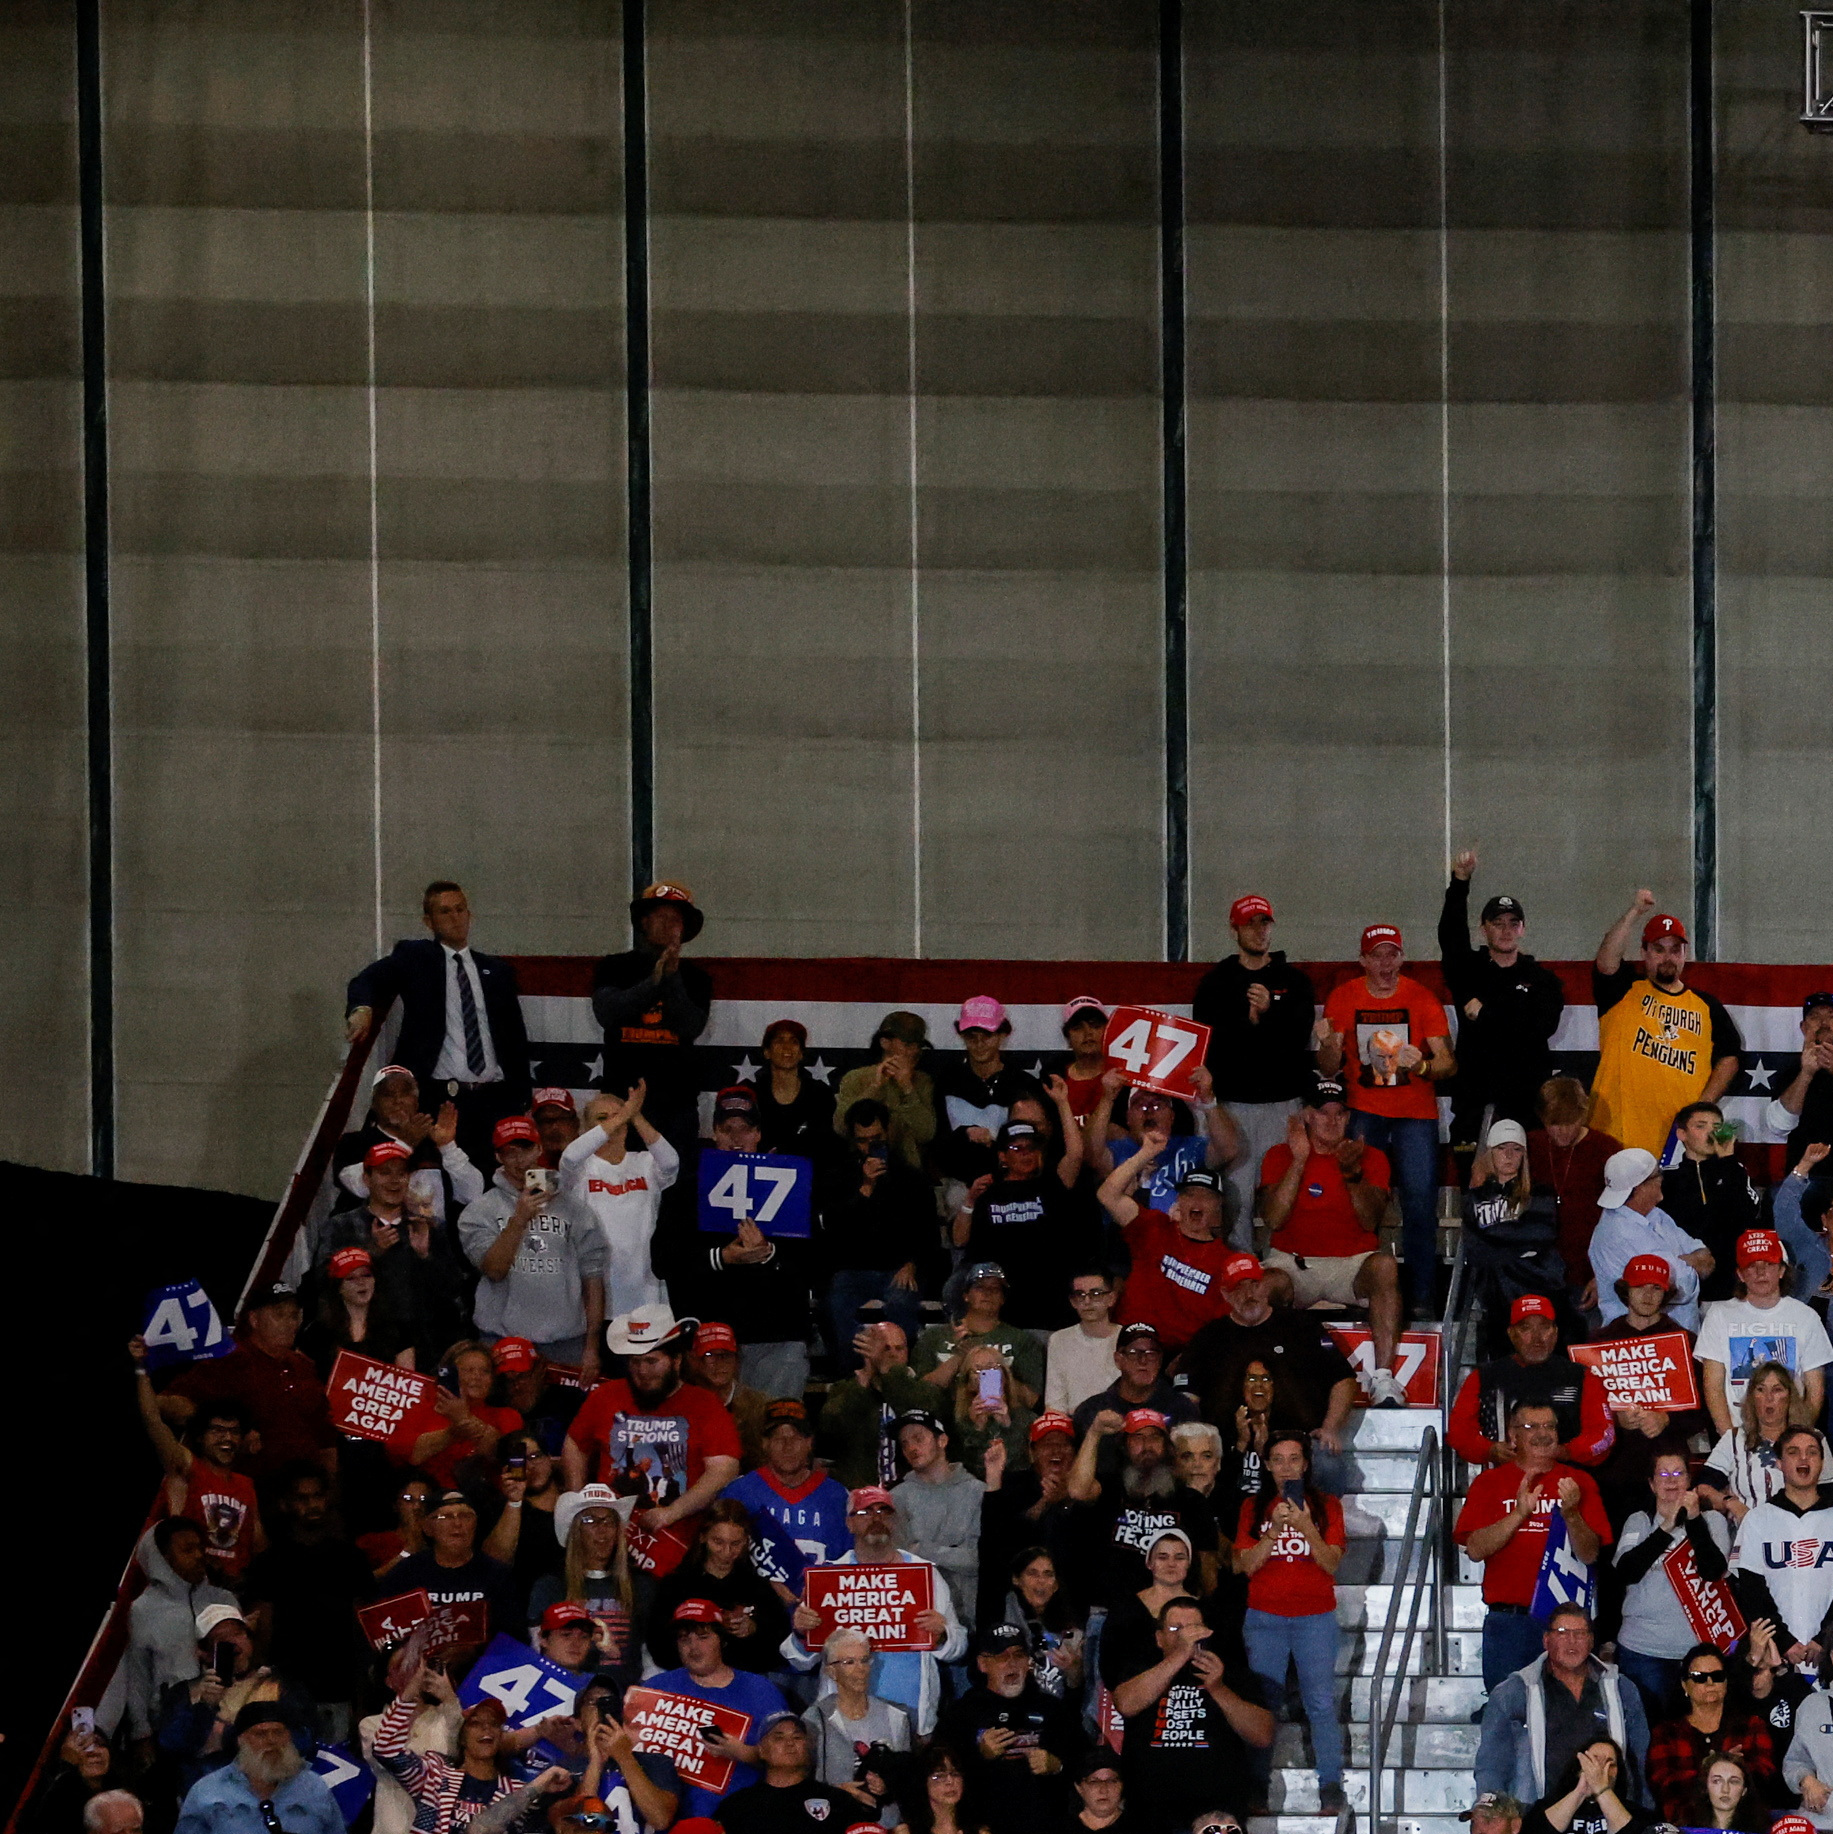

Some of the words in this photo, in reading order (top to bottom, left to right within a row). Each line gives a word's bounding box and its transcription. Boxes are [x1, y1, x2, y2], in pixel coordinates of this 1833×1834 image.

[1366, 928, 1396, 939] TRUMP
[1108, 1018, 1198, 1079] 47
[708, 1164, 798, 1222] 47
[1728, 1323, 1796, 1337] FIGHT
[1600, 1343, 1658, 1366] MAKE
[1590, 1357, 1677, 1379] AMERICA
[1602, 1372, 1665, 1393] GREAT
[1607, 1385, 1673, 1405] AGAIN!
[625, 1417, 678, 1432] TRUMP
[618, 1429, 680, 1444] STRONG
[838, 1573, 898, 1589] MAKE
[821, 1589, 916, 1607] AMERICA
[834, 1608, 903, 1625] GREAT
